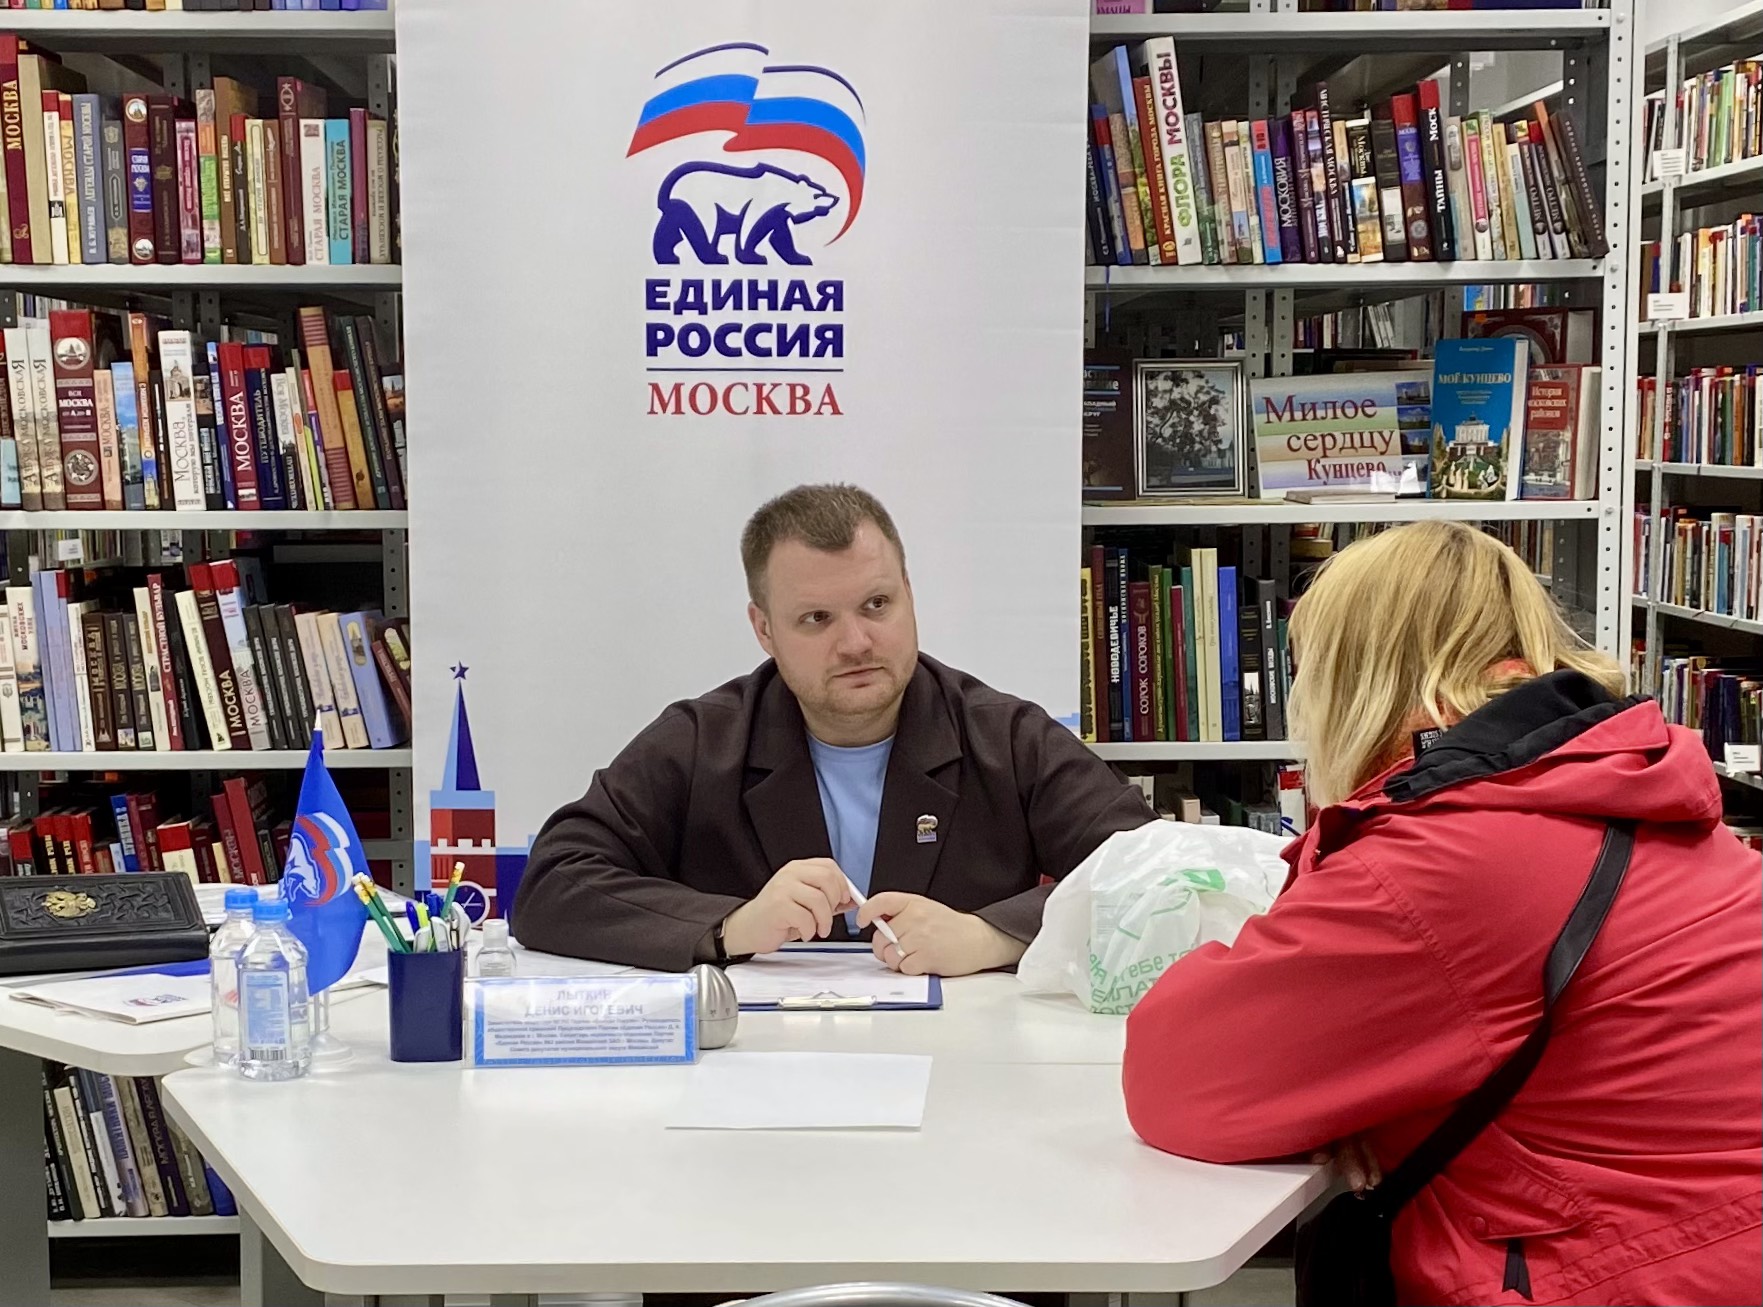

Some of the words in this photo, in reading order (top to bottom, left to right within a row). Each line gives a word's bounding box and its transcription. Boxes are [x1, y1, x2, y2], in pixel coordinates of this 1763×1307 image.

[2, 80, 22, 149] МОСКВА
[81, 102, 92, 134] МОСКВЫ
[1144, 84, 1156, 125] МОСКВЫ
[1156, 52, 1183, 145] МОСКВЫ
[1427, 106, 1439, 141] МОСК
[82, 134, 94, 165] СТАРОЙ
[1150, 126, 1161, 162] ГОРОДА
[61, 135, 74, 196] МОСКВА
[83, 166, 96, 201] ЛЕГЕНДЫ
[336, 140, 347, 190] МОСКВА
[1154, 163, 1165, 193] КНИГА
[1326, 157, 1338, 196] МОСКВА
[312, 166, 322, 214] МОСКВА
[1170, 153, 1193, 227] ФЛОРА
[1274, 156, 1293, 228] МОСКОВИЯ
[1435, 169, 1446, 212] ТАЙНЫ
[1530, 186, 1542, 220] МЕТРО
[1547, 187, 1559, 220] МЕТРО
[338, 194, 349, 241] СТАРАЯ
[1159, 194, 1172, 235] КРАСНАЯ
[313, 218, 324, 260] СТАРАЯ
[646, 279, 844, 315] ЕДИНАЯ
[646, 322, 844, 358] РОССИЯ
[33, 359, 52, 437] МОСКОВСКАЯ
[1438, 372, 1460, 384] МОЙ
[1463, 373, 1512, 384] КУНЦЕВО
[11, 360, 29, 437] МОСКОВСКАЯ
[59, 398, 94, 408] МОСКВА
[647, 382, 844, 415] МОСКВА
[1262, 395, 1377, 424] Милое
[100, 405, 112, 444] МОСКВА
[229, 391, 252, 472] МОСКВА
[254, 389, 269, 464] ПУТЕВОДИТЕЛЬ
[1286, 430, 1395, 459] сердцу
[189, 459, 200, 494] которую
[152, 582, 165, 620] БУЛЬВАР
[17, 602, 28, 650] МОСКОВСКИХ
[1109, 606, 1121, 683] НОВОДЕВИЧЬЕ
[157, 621, 171, 673] СТРАСТНОЙ
[1137, 625, 1149, 673] СОРОКОВ
[219, 669, 243, 728] МОСКВА
[240, 668, 261, 727] МОСКВА
[1139, 678, 1150, 714] СОРОК
[525, 1004, 569, 1018] ДЕНИС
[574, 1003, 644, 1017] ИГОЕВИЧ
[99, 1076, 114, 1099] МОС
